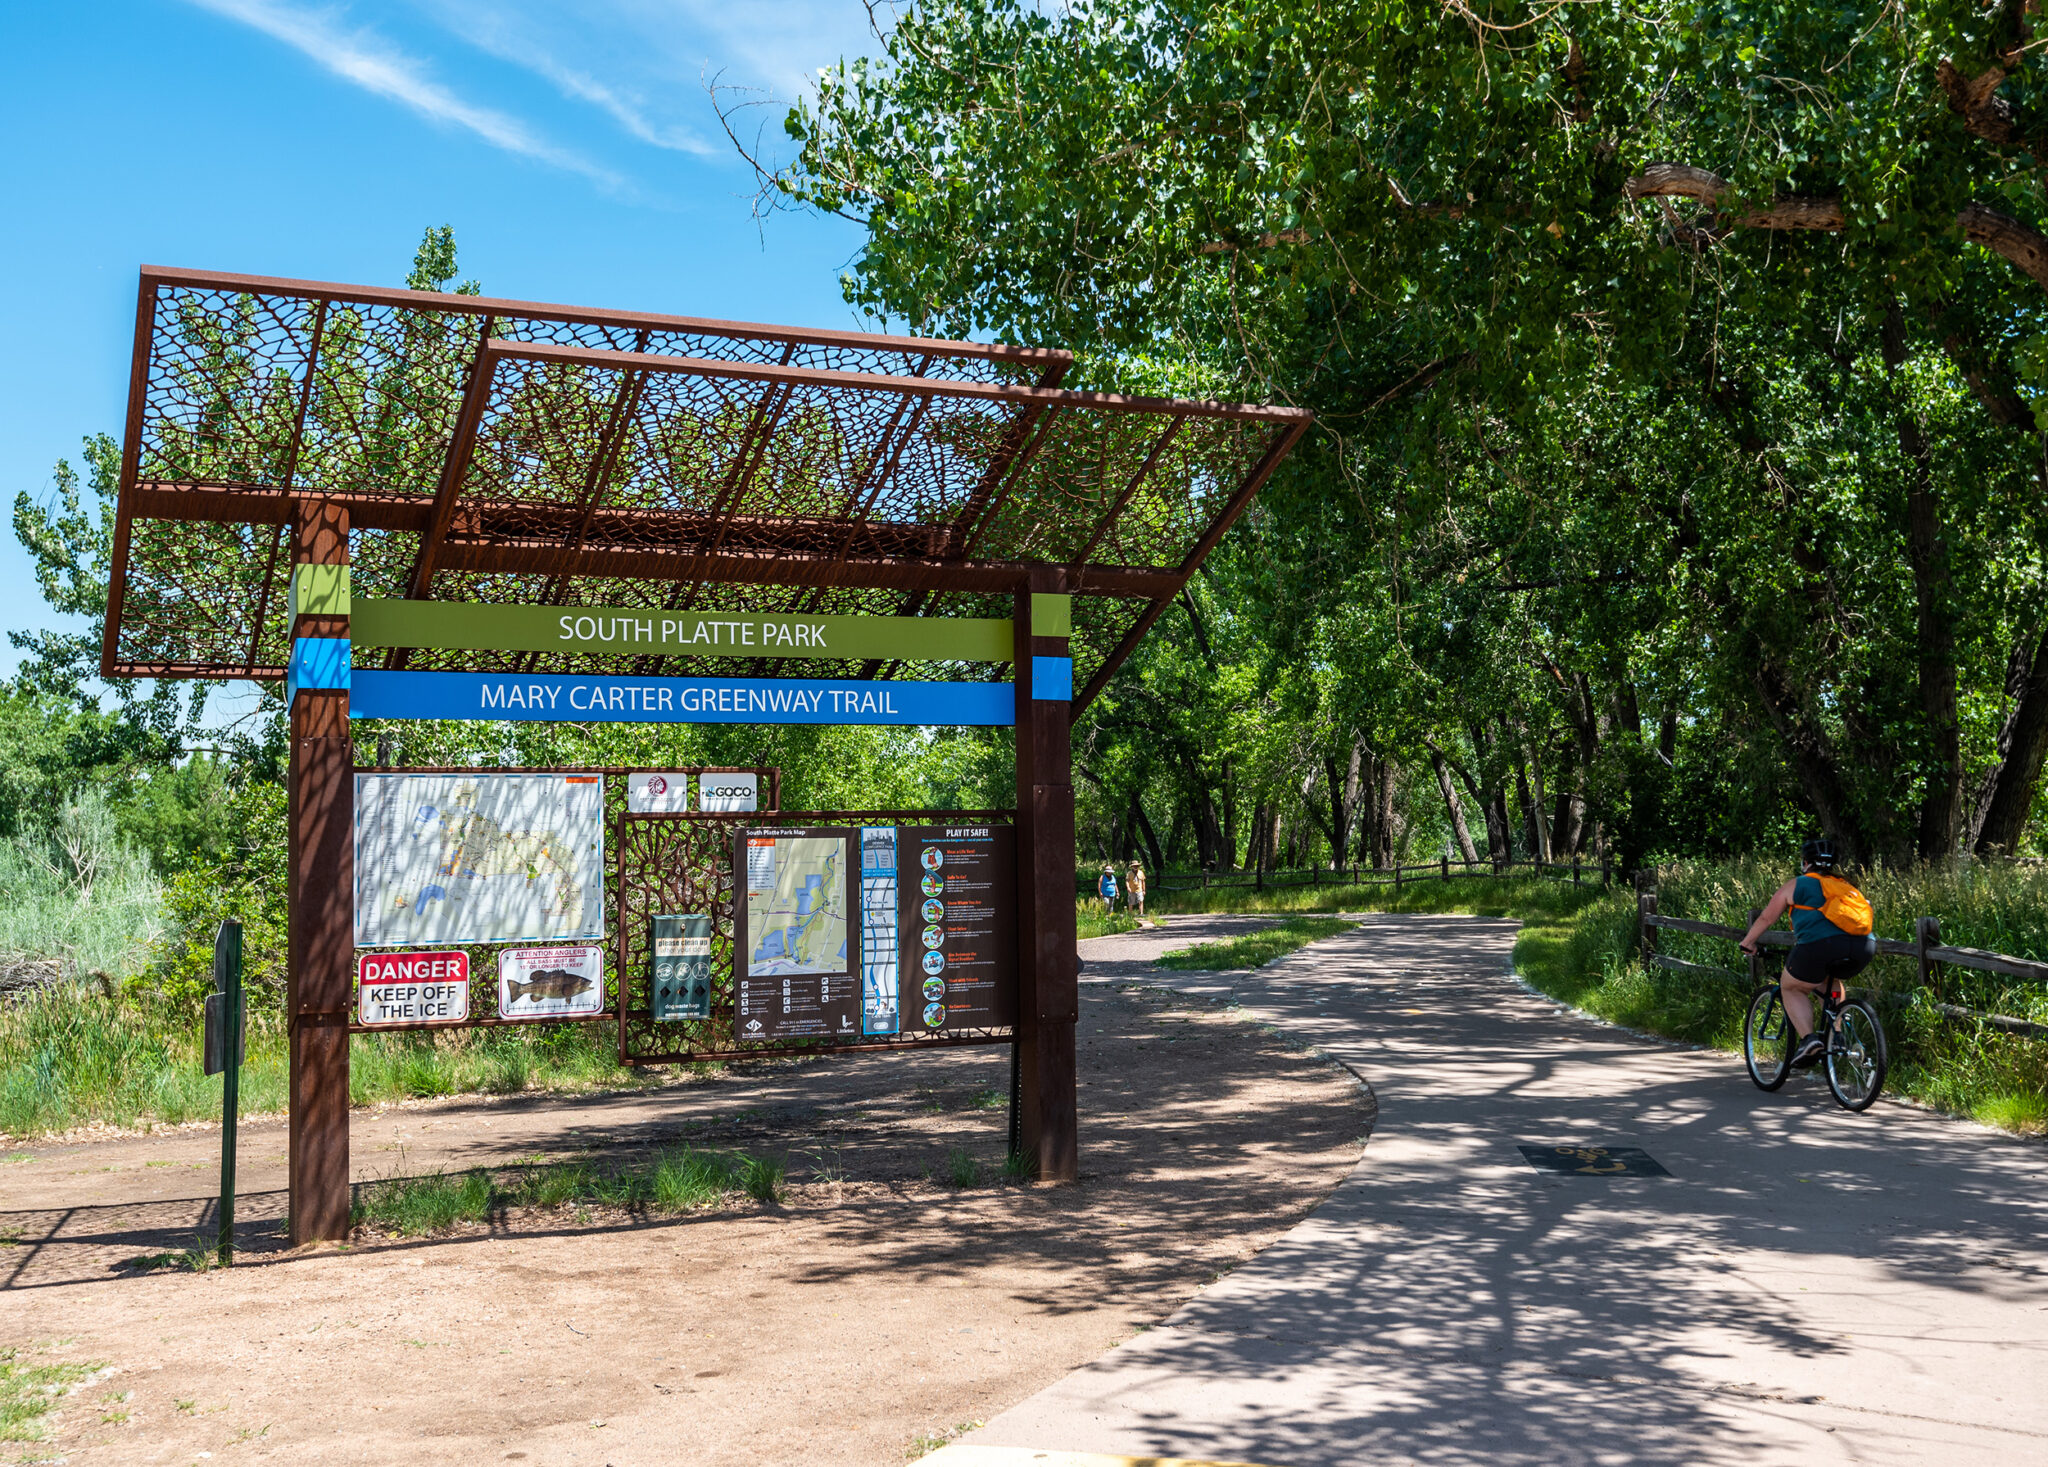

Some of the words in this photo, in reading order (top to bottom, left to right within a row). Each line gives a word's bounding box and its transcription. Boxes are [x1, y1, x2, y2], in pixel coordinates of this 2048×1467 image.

[559, 615, 653, 643] SOUTH
[661, 619, 756, 646] PLATTE
[763, 622, 828, 648] PARK
[481, 684, 563, 710] MARY
[569, 685, 674, 712] CARTER
[680, 687, 824, 714] GREENWAY
[828, 690, 899, 715] TRAIL
[715, 786, 752, 797] GOCO
[946, 829, 963, 837] PLAY
[963, 829, 970, 837] IT
[970, 828, 989, 837] SAFE!
[365, 960, 462, 981] DANGER
[371, 987, 417, 1002] KEEP
[422, 985, 457, 1000] OFF
[379, 1005, 414, 1019] THE
[420, 1003, 448, 1017] ICE
